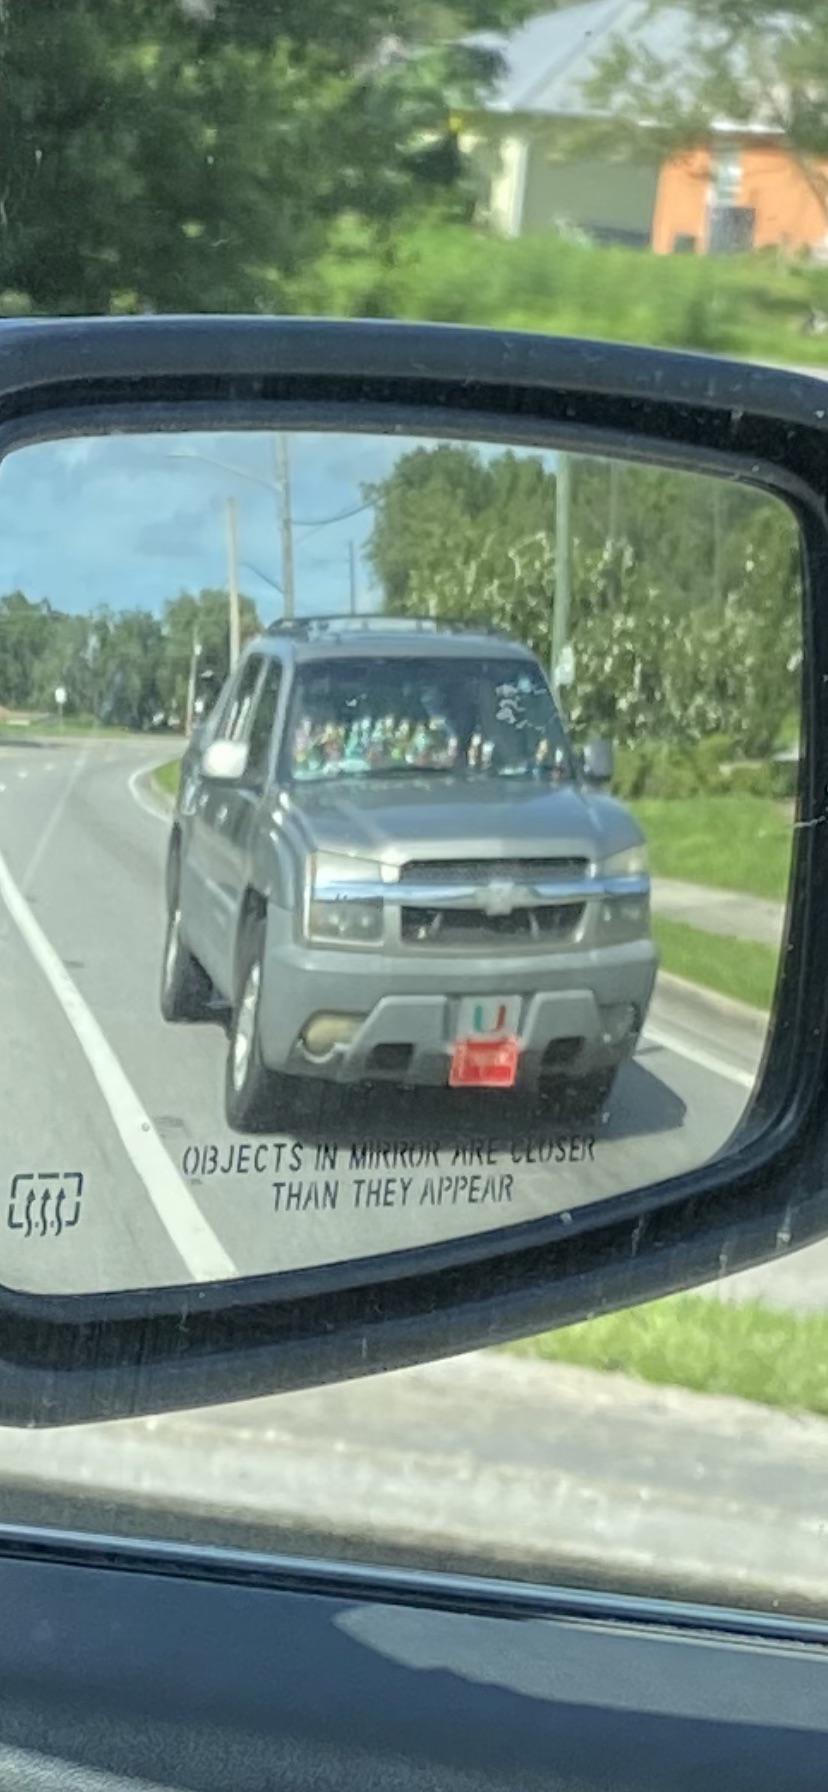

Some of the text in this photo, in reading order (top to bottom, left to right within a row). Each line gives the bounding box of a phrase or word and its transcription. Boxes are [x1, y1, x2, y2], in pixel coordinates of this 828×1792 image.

[182, 1134, 597, 1177] OBJECTS IN MIRROR ARE CLOSER
[271, 1173, 515, 1212] THAN THEY APPEAR
